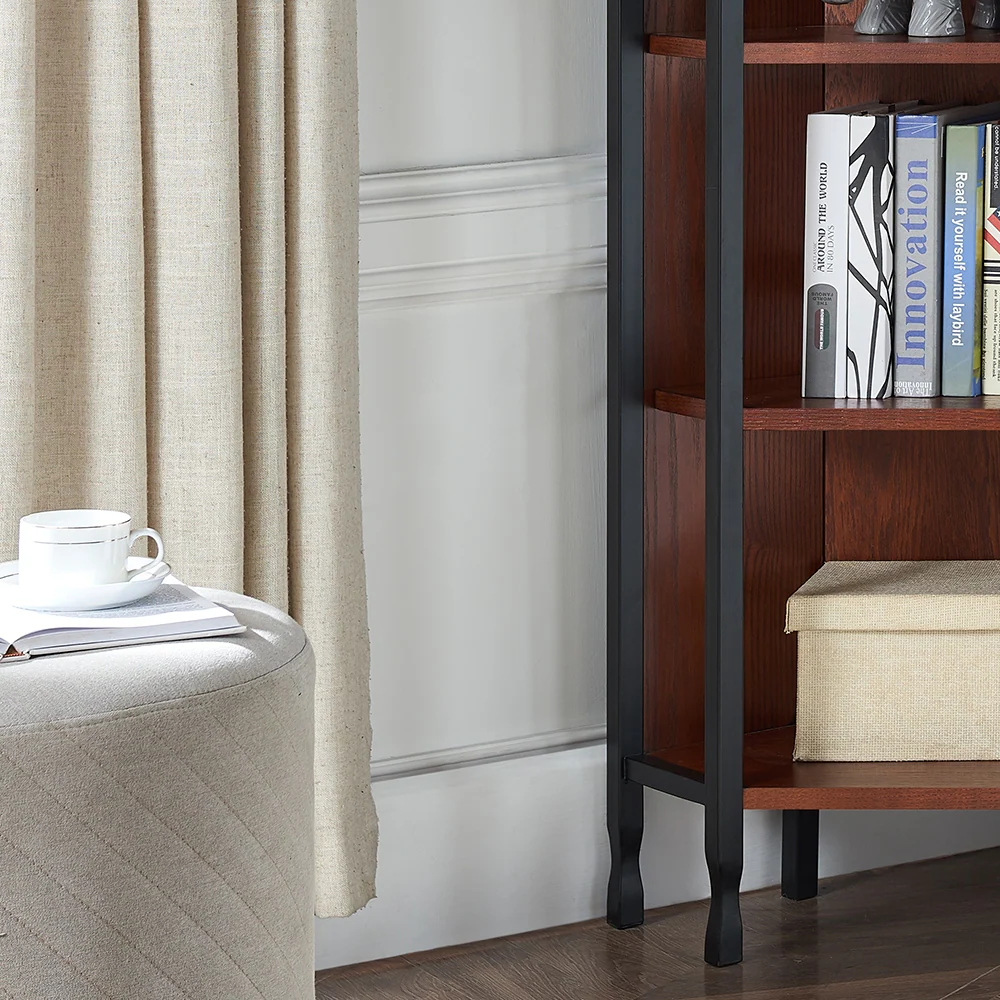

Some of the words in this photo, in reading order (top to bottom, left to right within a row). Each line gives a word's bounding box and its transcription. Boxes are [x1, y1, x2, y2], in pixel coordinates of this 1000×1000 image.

[819, 162, 828, 200] WORLD
[954, 172, 968, 204] Read
[818, 203, 827, 224] THE
[954, 208, 967, 216] it
[817, 228, 826, 272] AROUND
[827, 224, 835, 248] DAYS
[952, 219, 966, 271] yourself
[826, 264, 834, 273] IN
[827, 250, 834, 261] 80
[896, 158, 928, 370] Innovation
[952, 273, 966, 296] with
[950, 304, 965, 346] laybird
